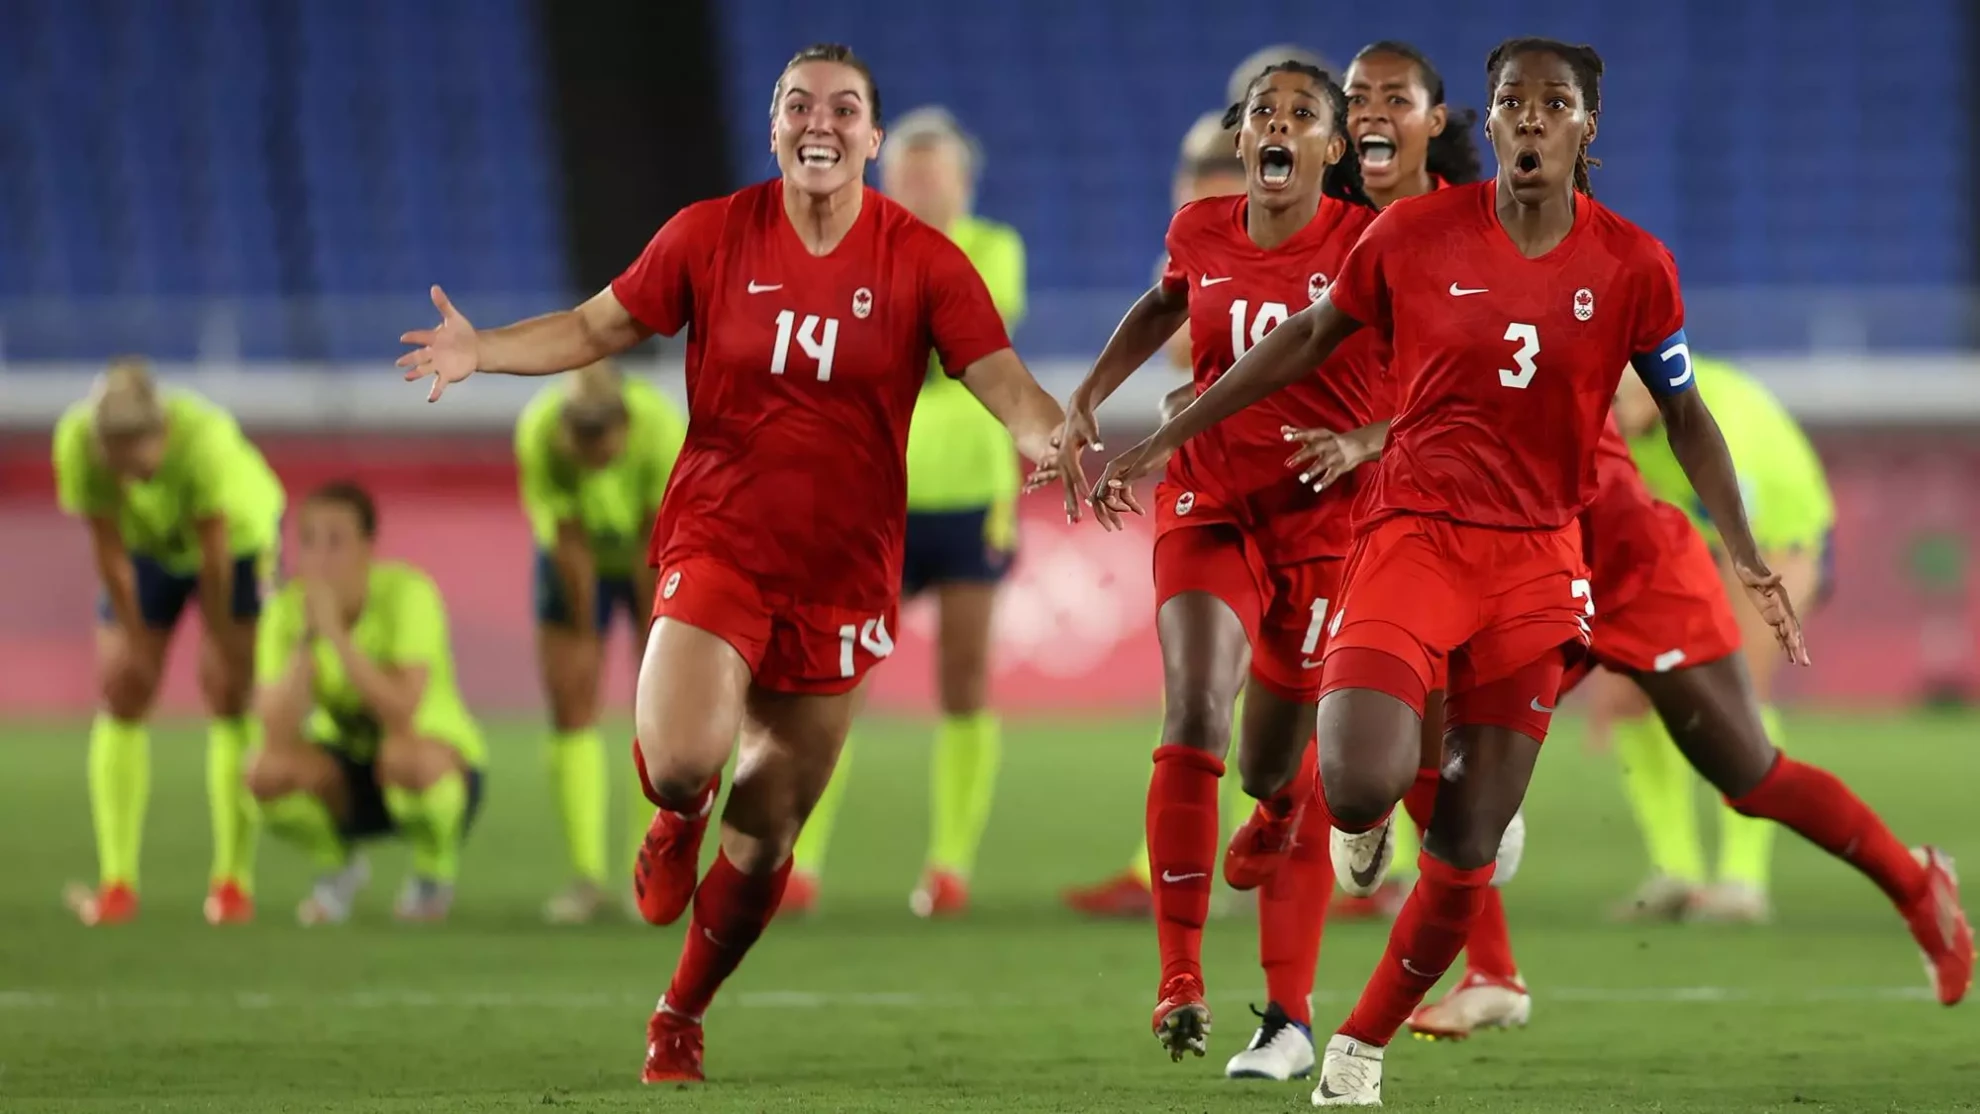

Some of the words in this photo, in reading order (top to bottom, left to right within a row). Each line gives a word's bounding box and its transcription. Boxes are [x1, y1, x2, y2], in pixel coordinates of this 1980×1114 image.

[770, 309, 839, 382] 14
[1499, 322, 1541, 389] 3
[1301, 597, 1331, 655] 1
